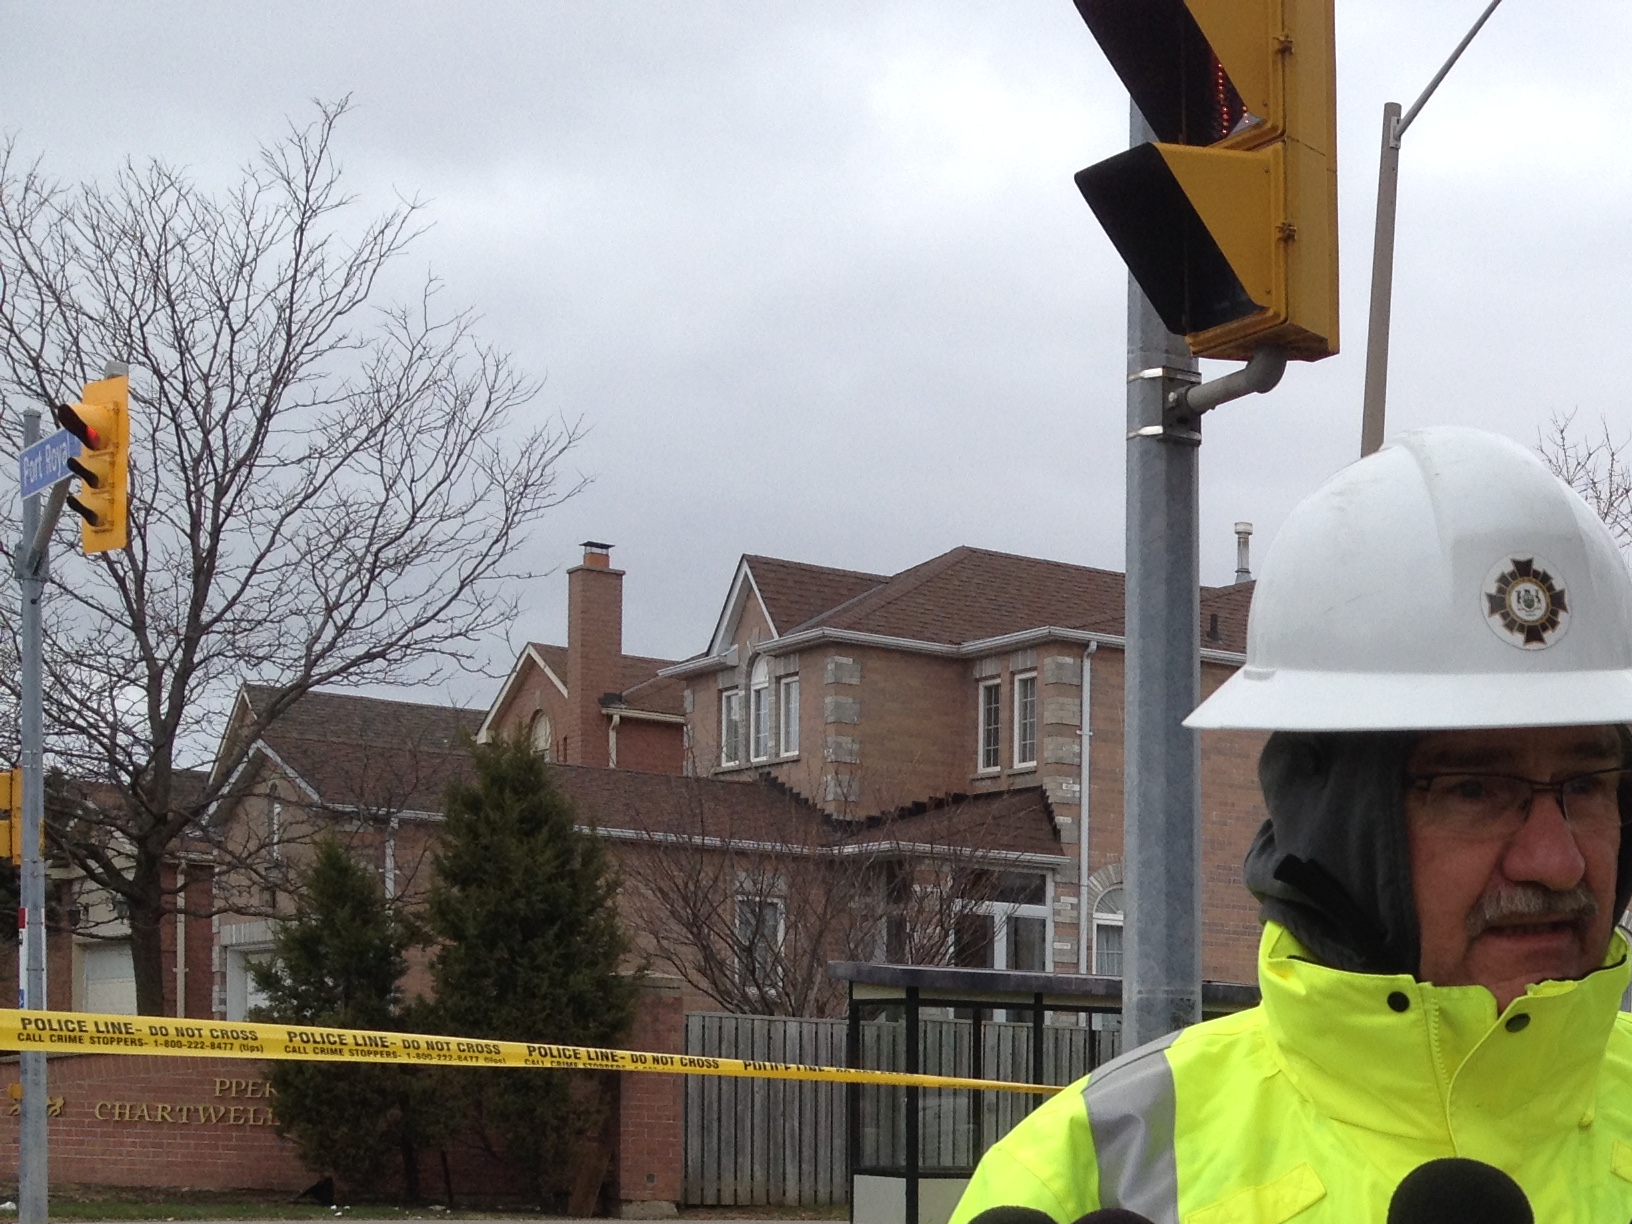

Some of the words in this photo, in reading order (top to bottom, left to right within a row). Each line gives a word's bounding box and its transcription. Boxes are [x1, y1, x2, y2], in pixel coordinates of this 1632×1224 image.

[20, 1017, 88, 1033] POLICE
[148, 1025, 169, 1037] DO
[174, 1026, 204, 1038] NOT
[209, 1028, 259, 1041] CROSS
[17, 1032, 45, 1043] CALL
[49, 1034, 85, 1045] CRIME
[153, 1039, 235, 1051] 1-800-222-8477
[239, 1043, 264, 1054] (tips)
[284, 1044, 310, 1055] CALL
[312, 1046, 345, 1057] CRIME
[286, 1030, 349, 1046] POLICE
[401, 1038, 421, 1051] DO
[425, 1040, 452, 1053] NOT
[456, 1042, 502, 1055] CROSS
[526, 1044, 582, 1060] POLICE
[630, 1053, 648, 1065] DO
[652, 1054, 675, 1067] NOT
[679, 1056, 720, 1069] CROSS
[94, 1102, 281, 1126] CHARTWELL
